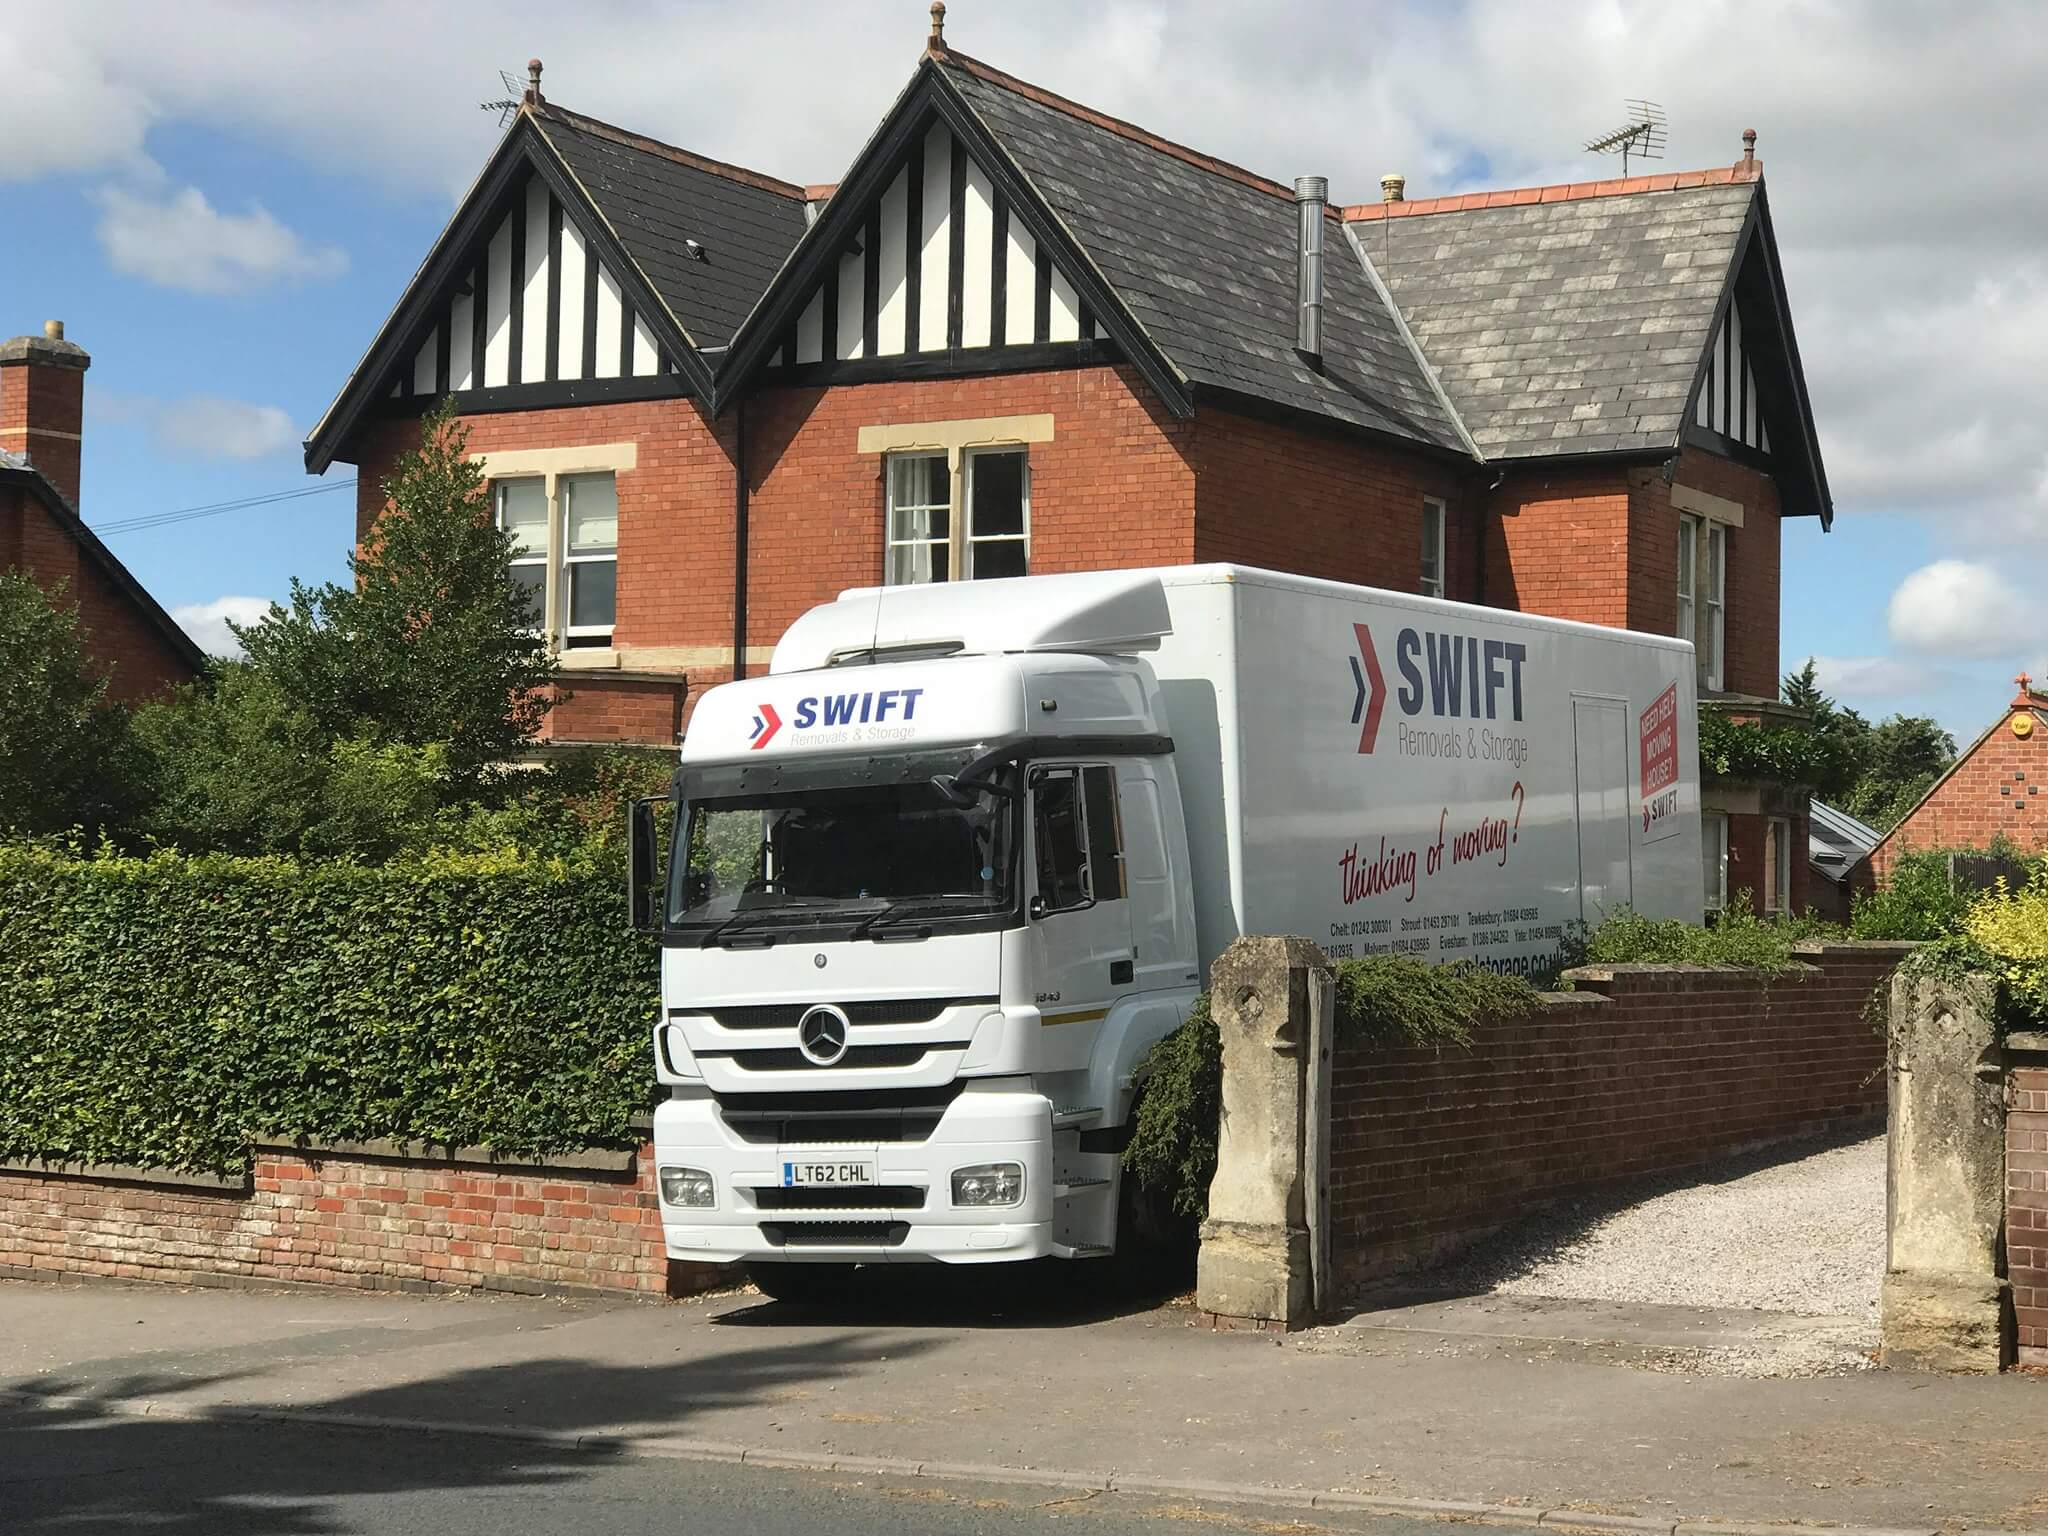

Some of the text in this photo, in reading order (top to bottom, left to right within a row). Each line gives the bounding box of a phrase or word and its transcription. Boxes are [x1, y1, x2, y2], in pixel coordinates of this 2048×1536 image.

[1396, 628, 1527, 722] SWIFT
[794, 688, 924, 729] SWIFT
[1640, 690, 1676, 738] NEED HELP
[790, 725, 916, 747] Removals & Storage
[1400, 722, 1528, 769] Removals & Storage
[1646, 726, 1672, 762] MOVING
[1646, 757, 1673, 790] HOUSE?
[1651, 789, 1678, 821] SWIFT
[1338, 835, 1417, 905] thinking
[1427, 807, 1449, 876] of
[794, 1164, 870, 1182] LT62 CHL
